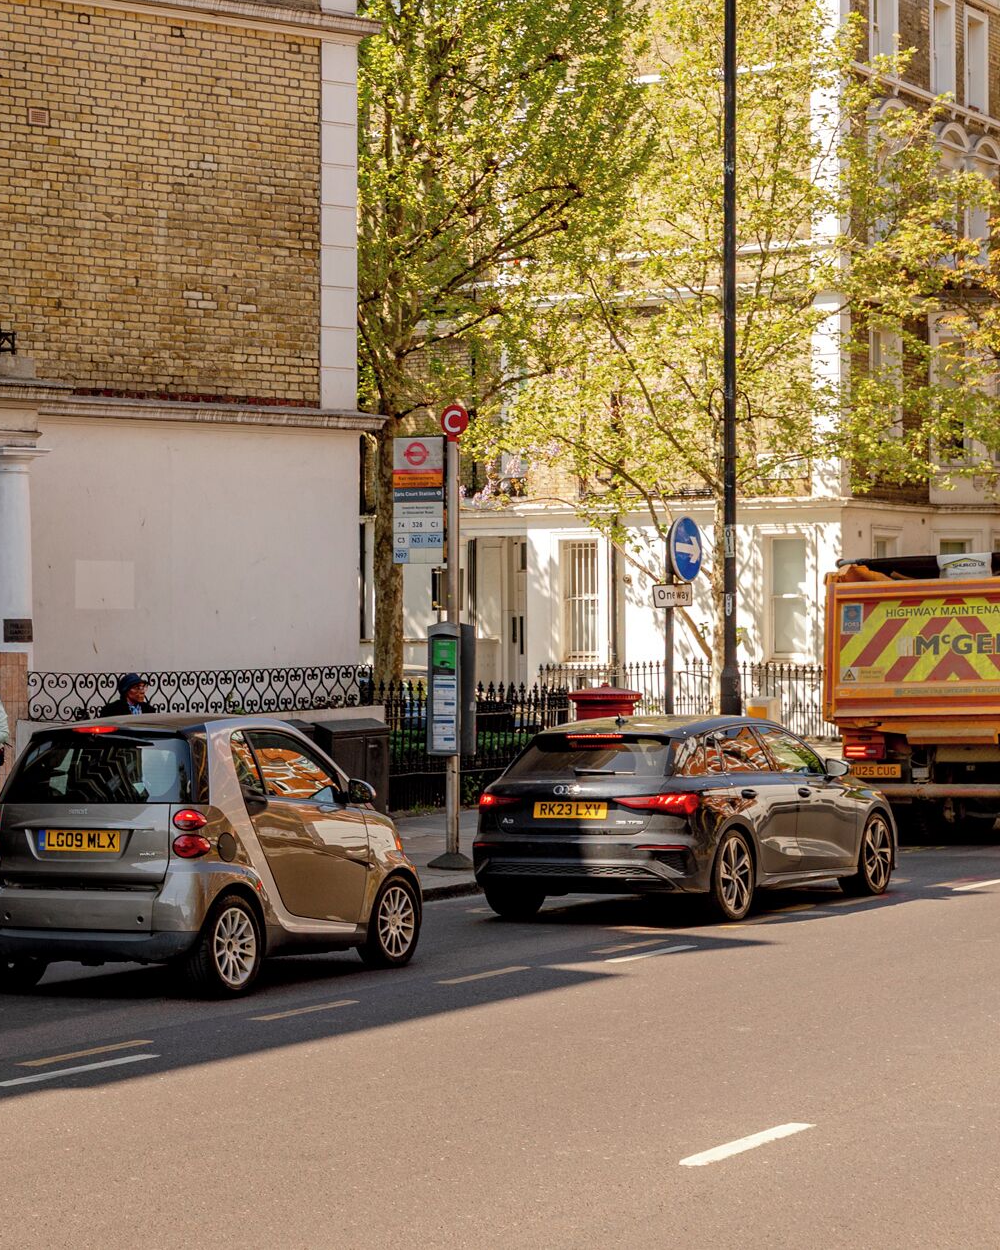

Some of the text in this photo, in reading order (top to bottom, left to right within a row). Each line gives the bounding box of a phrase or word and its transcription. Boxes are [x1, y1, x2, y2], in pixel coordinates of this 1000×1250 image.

[444, 410, 462, 433] C
[658, 589, 690, 602] One way
[885, 607, 938, 618] HIGHWAY
[876, 766, 897, 776] CUG
[539, 803, 601, 816] RK23 LXV
[47, 832, 116, 848] LG09 MLX
